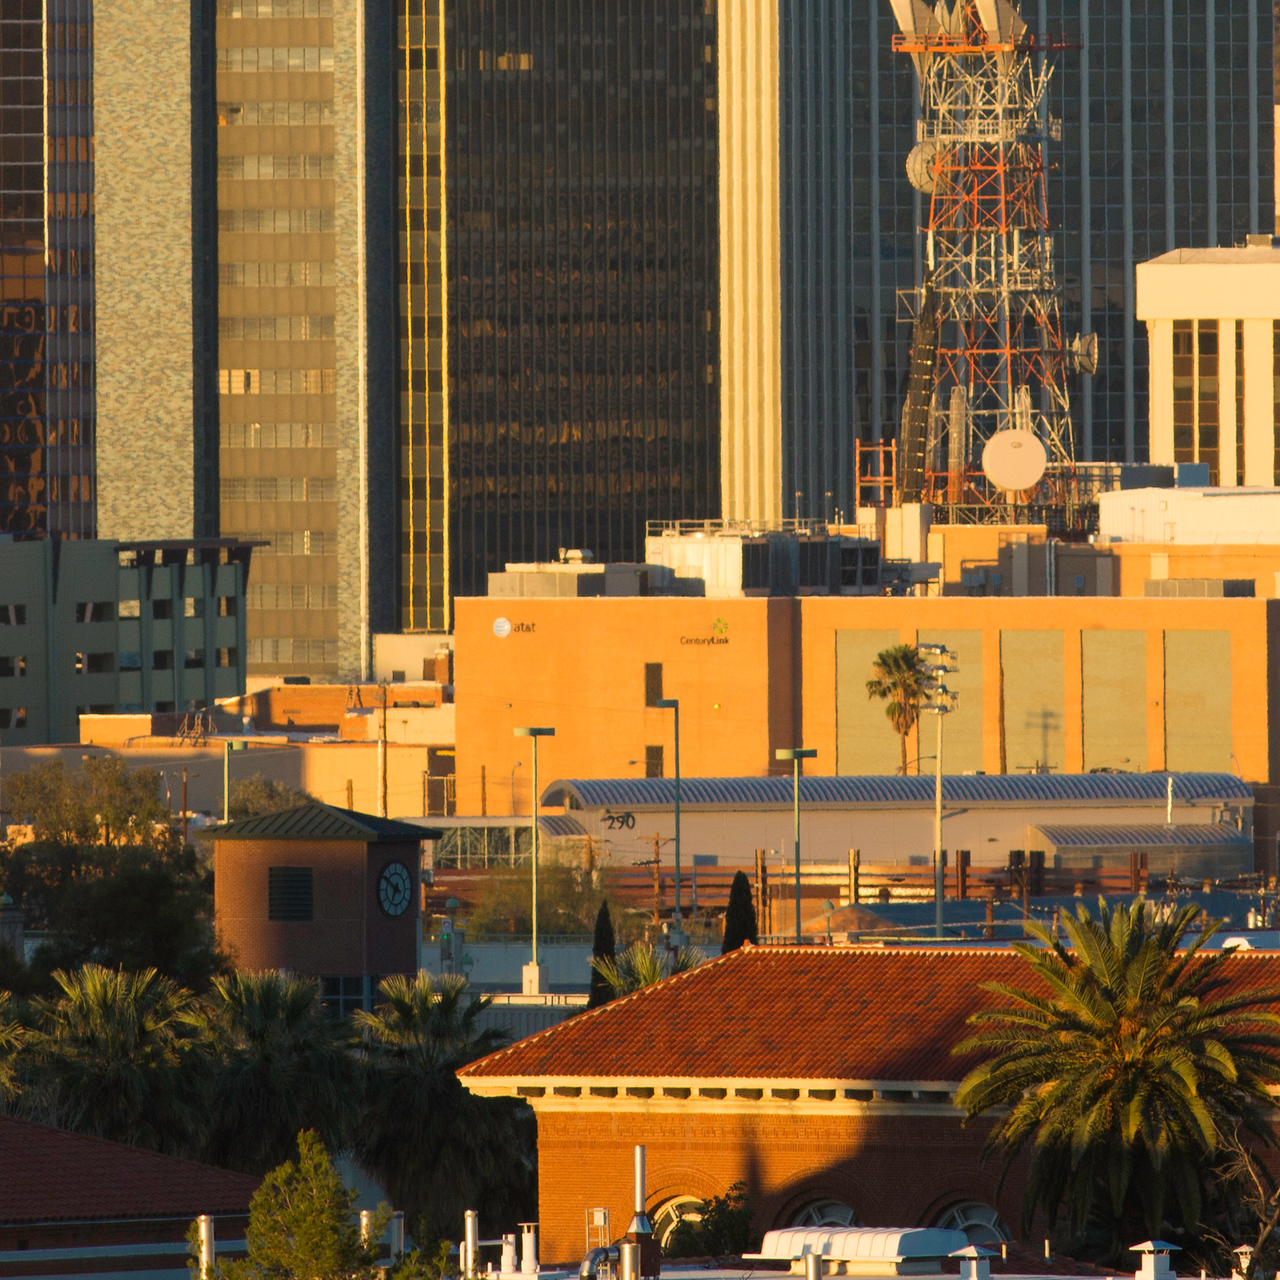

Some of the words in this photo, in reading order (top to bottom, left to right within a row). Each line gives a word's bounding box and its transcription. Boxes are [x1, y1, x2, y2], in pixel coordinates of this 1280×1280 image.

[514, 622, 536, 633] at&t
[680, 635, 729, 647] CenturyLink
[606, 814, 636, 830] 290
